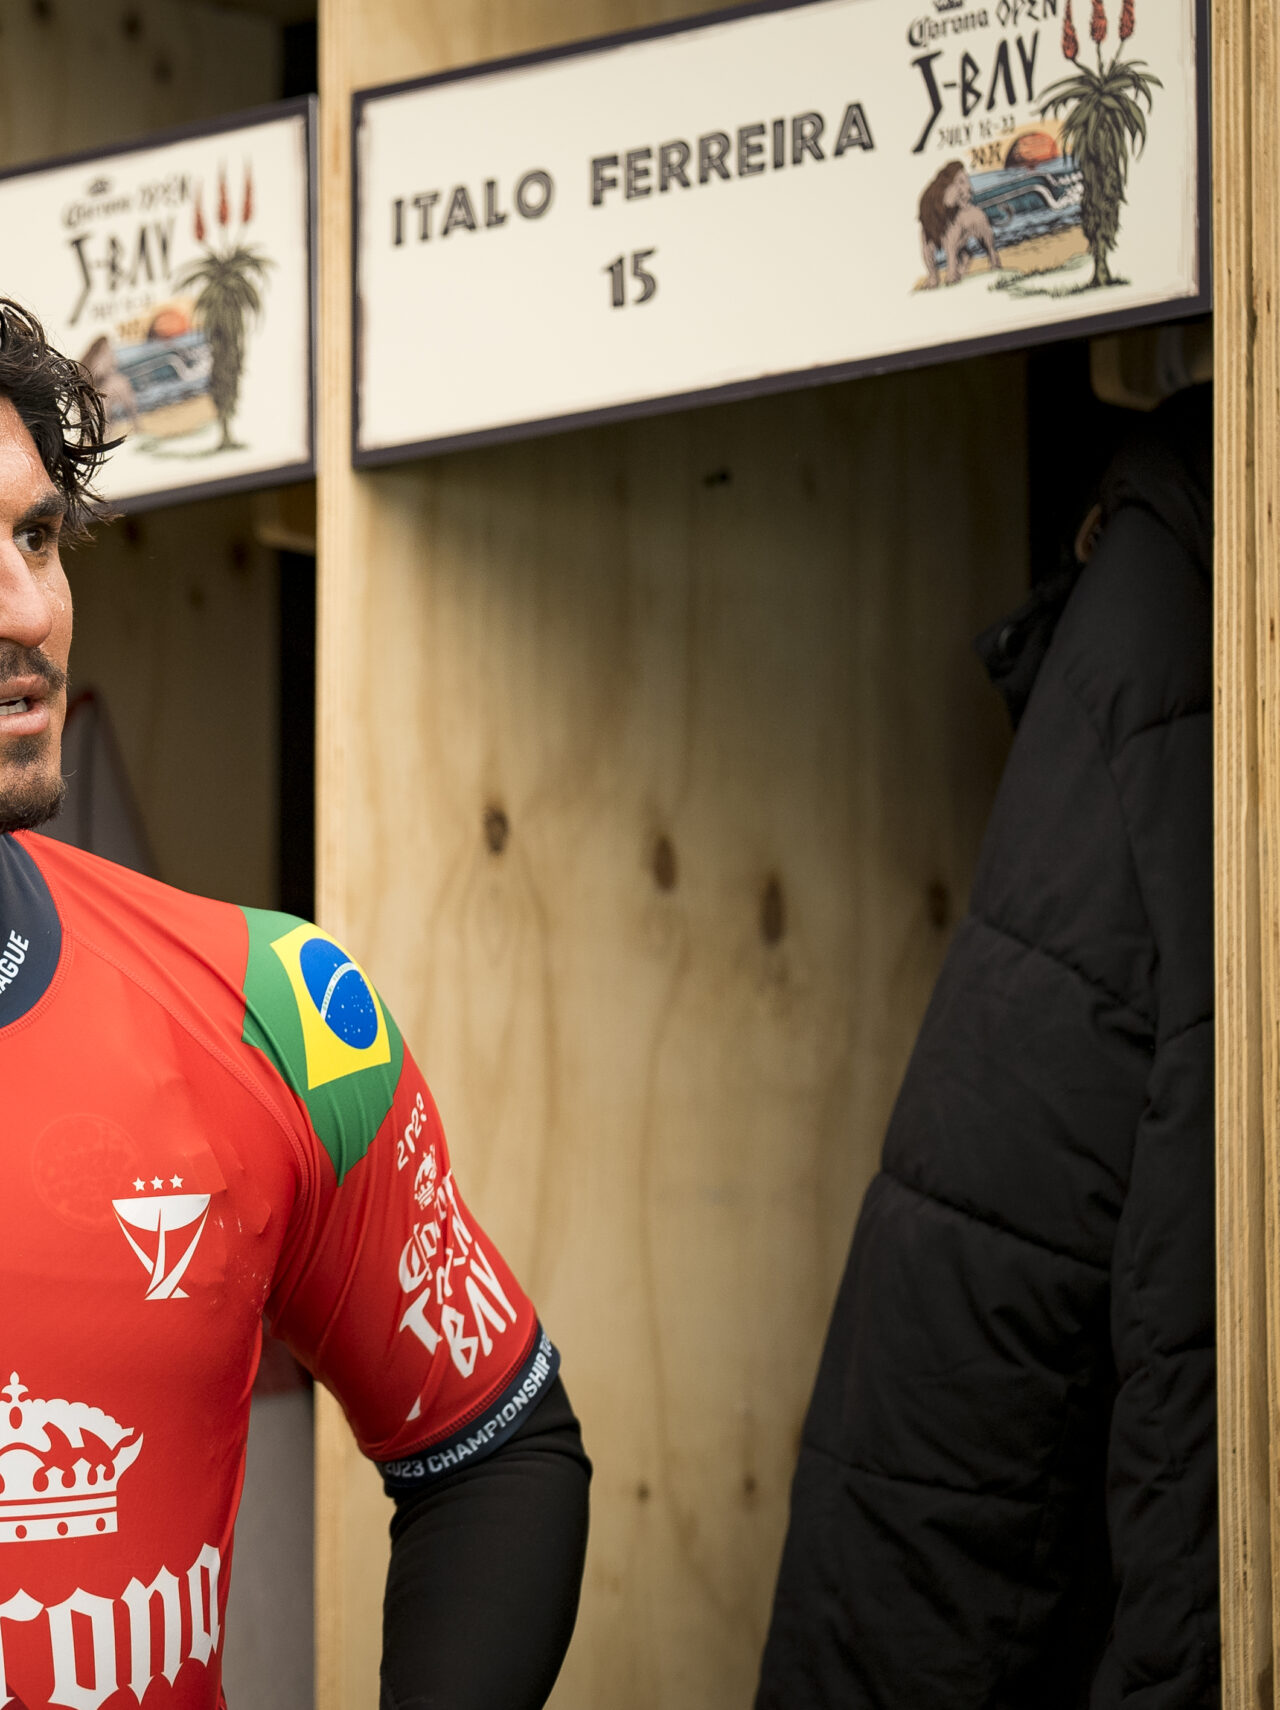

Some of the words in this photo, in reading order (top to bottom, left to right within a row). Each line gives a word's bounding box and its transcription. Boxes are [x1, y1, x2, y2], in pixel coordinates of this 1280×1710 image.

[907, 8, 989, 48] Corona
[911, 29, 1040, 155] J-BAY
[392, 168, 554, 247] ITALO
[589, 101, 876, 208] FERREIRA
[604, 247, 658, 310] 15
[427, 1352, 551, 1473] CHAMPIONSHIP
